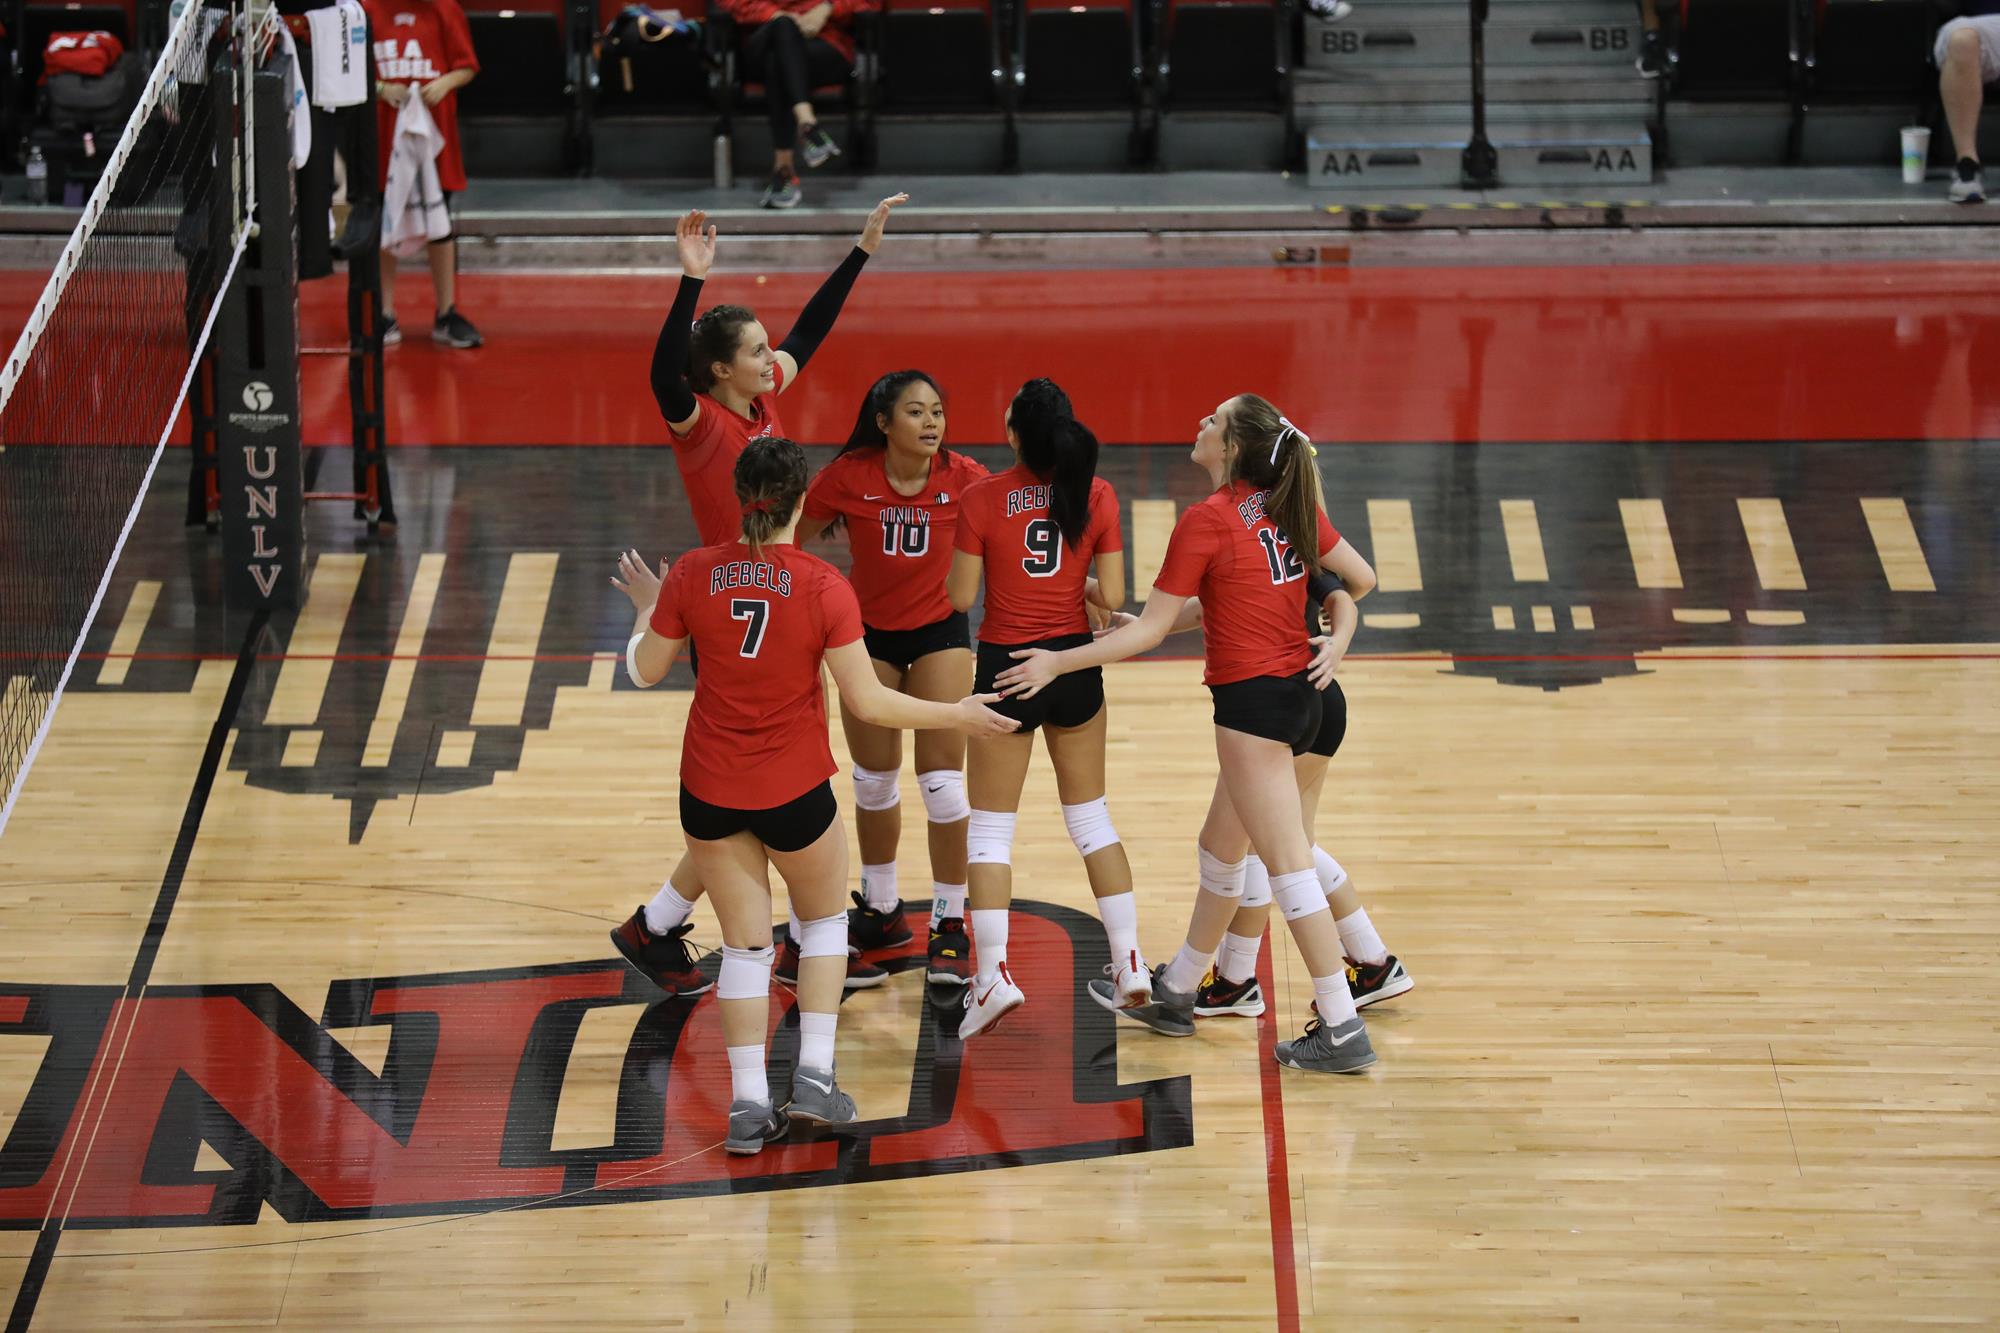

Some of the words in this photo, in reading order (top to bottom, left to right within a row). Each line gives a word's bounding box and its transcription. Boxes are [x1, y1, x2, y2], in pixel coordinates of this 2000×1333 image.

[403, 39, 422, 59] A
[1322, 31, 1358, 54] BB
[1591, 28, 1628, 51] BB
[1322, 152, 1363, 175] AA
[1594, 148, 1637, 172] AA
[243, 446, 282, 598] UNLV
[882, 521, 930, 557] 10
[1022, 518, 1063, 577] 9
[1258, 526, 1305, 585] 12
[710, 561, 791, 597] REBELS
[731, 598, 769, 658] 7
